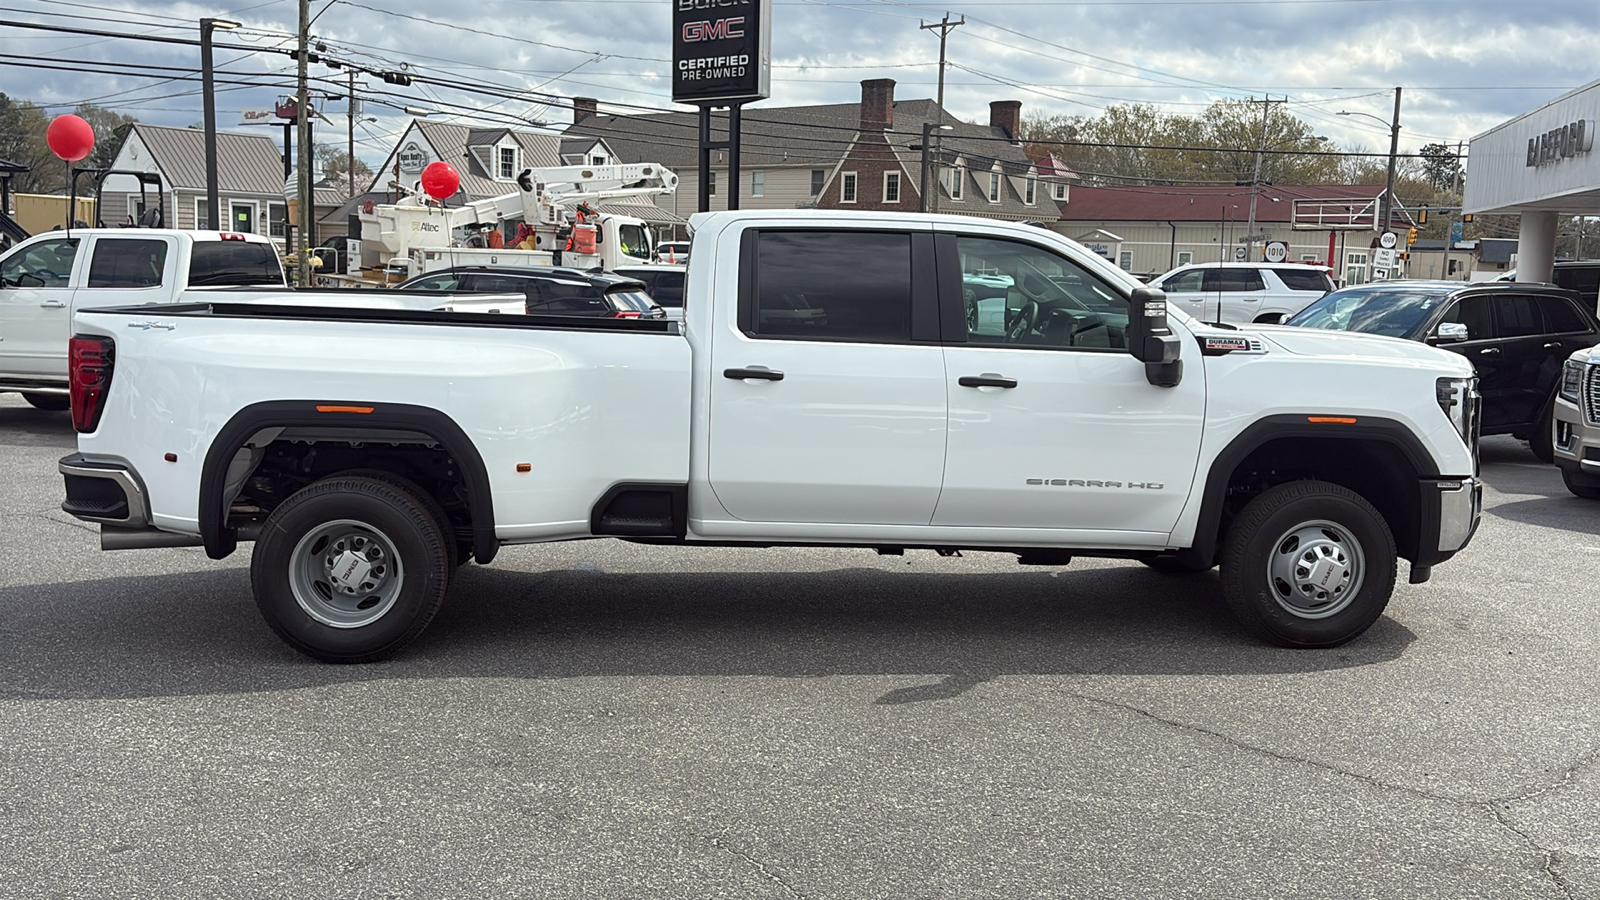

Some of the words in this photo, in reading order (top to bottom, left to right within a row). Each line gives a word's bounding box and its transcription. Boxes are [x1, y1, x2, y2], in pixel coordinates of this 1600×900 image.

[678, 0, 750, 11] BUI
[683, 17, 744, 42] GMC
[679, 55, 749, 70] CERTIFIED
[682, 67, 745, 80] PRE-OWNED
[1526, 119, 1595, 167] BAREFORD
[420, 222, 439, 232] Altec
[1383, 236, 1395, 244] 1008
[1268, 248, 1284, 256] 1010
[1026, 478, 1122, 487] SIERRA
[342, 560, 359, 580] GMC
[1321, 565, 1335, 584] GMC
